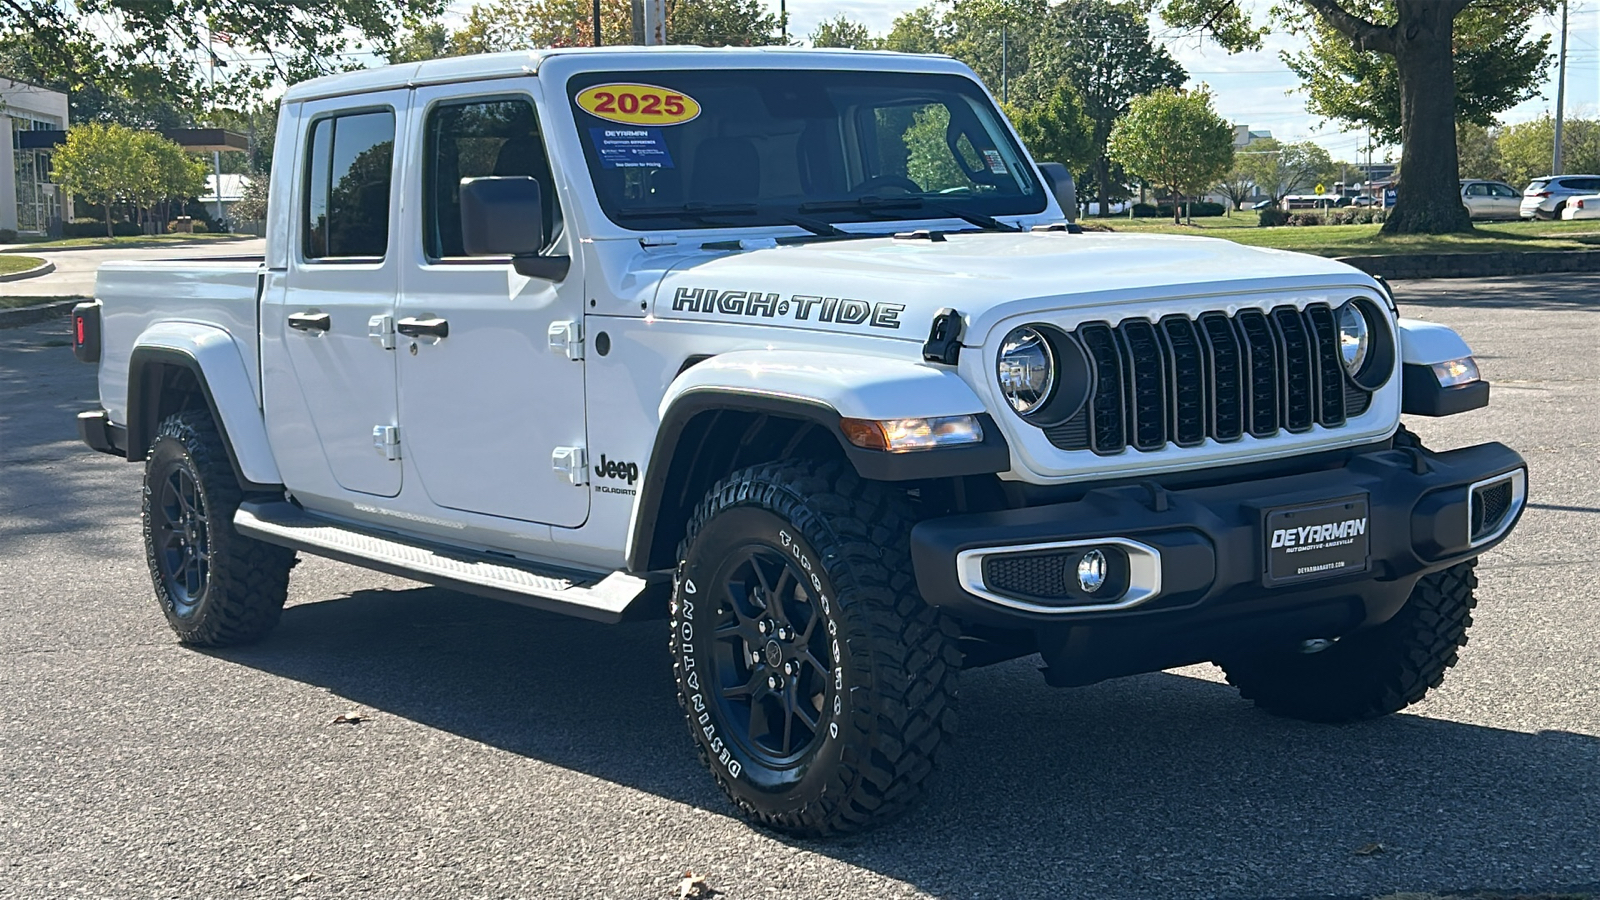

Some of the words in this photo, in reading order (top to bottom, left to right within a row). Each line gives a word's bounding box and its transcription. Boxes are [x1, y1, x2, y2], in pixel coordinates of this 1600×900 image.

[593, 91, 685, 116] 2025
[672, 288, 780, 318] HIGH
[791, 295, 906, 329] TIDE
[594, 453, 638, 485] Jeep
[602, 486, 637, 496] GLADIATO
[1271, 517, 1366, 549] DEYARMAN
[682, 599, 742, 779] DESTINATION
